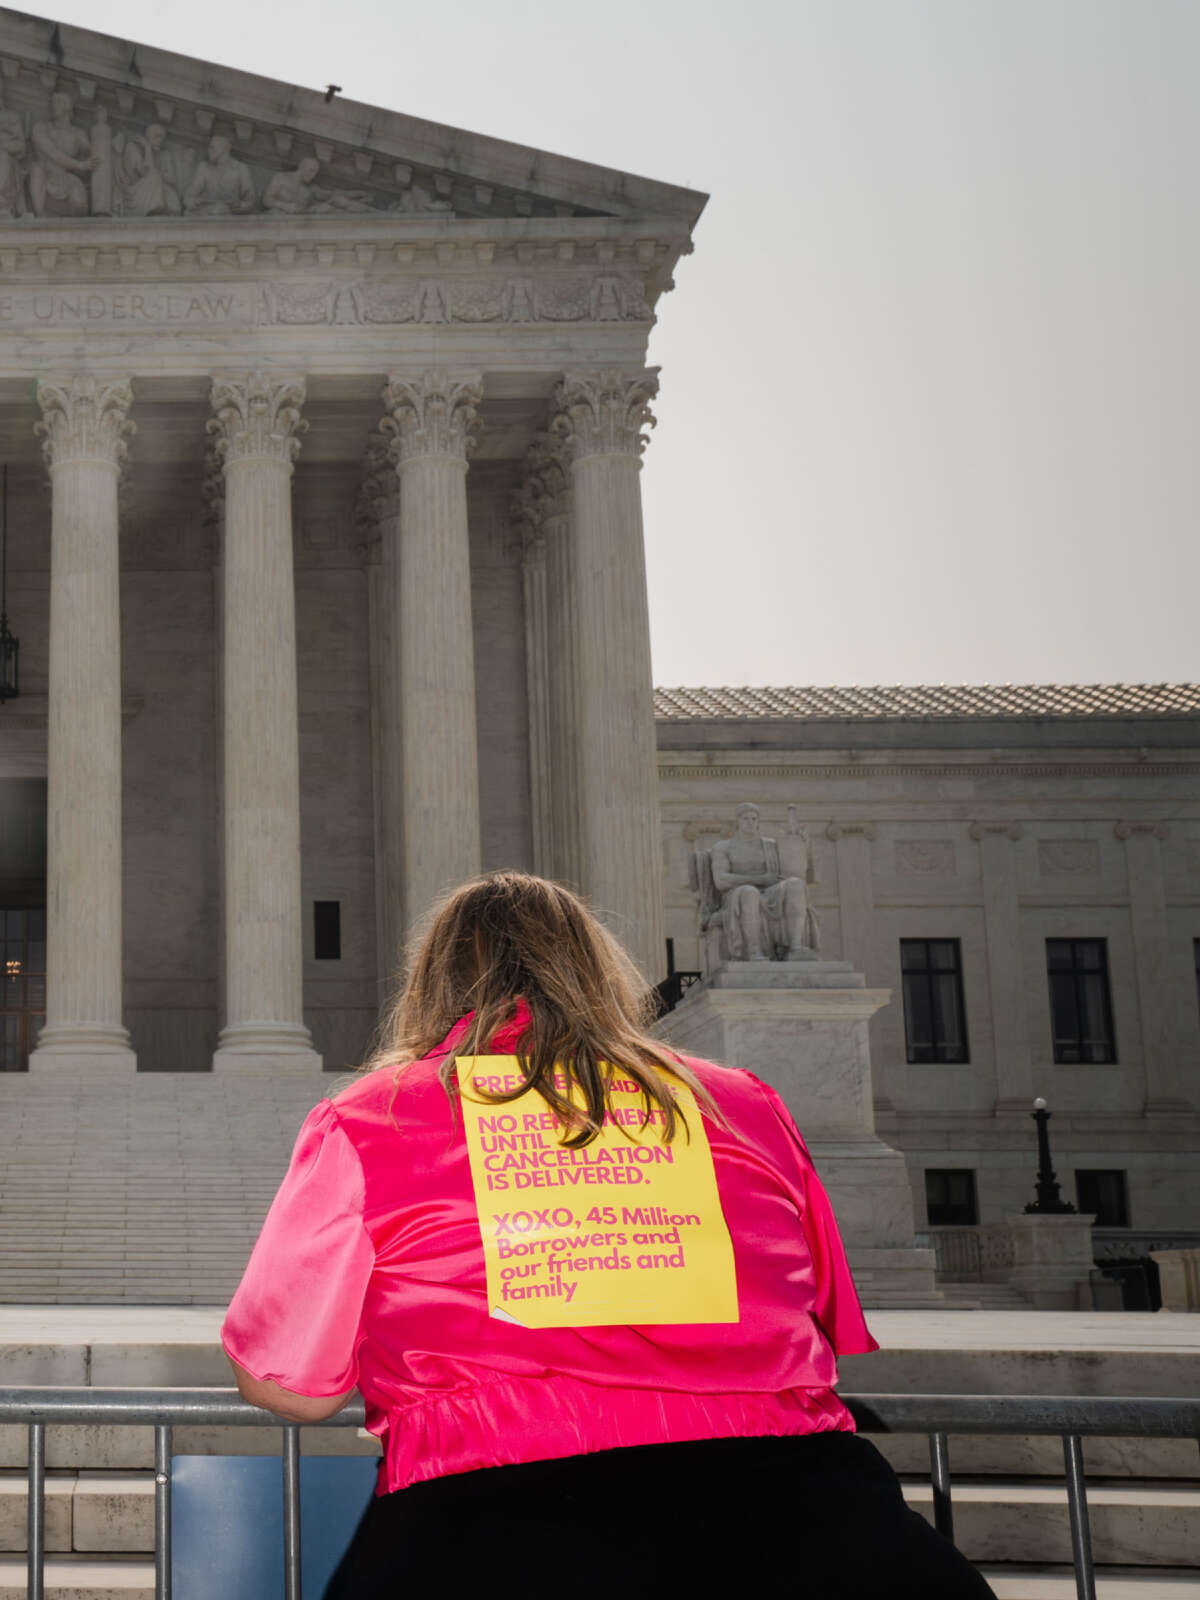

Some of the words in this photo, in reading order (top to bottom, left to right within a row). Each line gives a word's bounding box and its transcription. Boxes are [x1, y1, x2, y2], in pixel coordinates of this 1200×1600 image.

[32, 295, 154, 320] UNDER
[167, 294, 233, 319] LAW
[477, 1114, 518, 1134] NO
[523, 1108, 667, 1132] REPMENT
[480, 1133, 551, 1153] UNTIL
[483, 1146, 674, 1173] CANCELLATION
[486, 1173, 509, 1191] IS
[515, 1166, 651, 1189] DELIVERED.
[492, 1207, 582, 1236] XOXO,
[586, 1207, 618, 1226] 45
[621, 1206, 702, 1227] Million
[496, 1229, 628, 1260] Borrowers
[632, 1227, 682, 1245] and
[500, 1262, 543, 1281] our
[546, 1247, 632, 1275] friends
[636, 1246, 686, 1269] and
[500, 1275, 579, 1303] family
